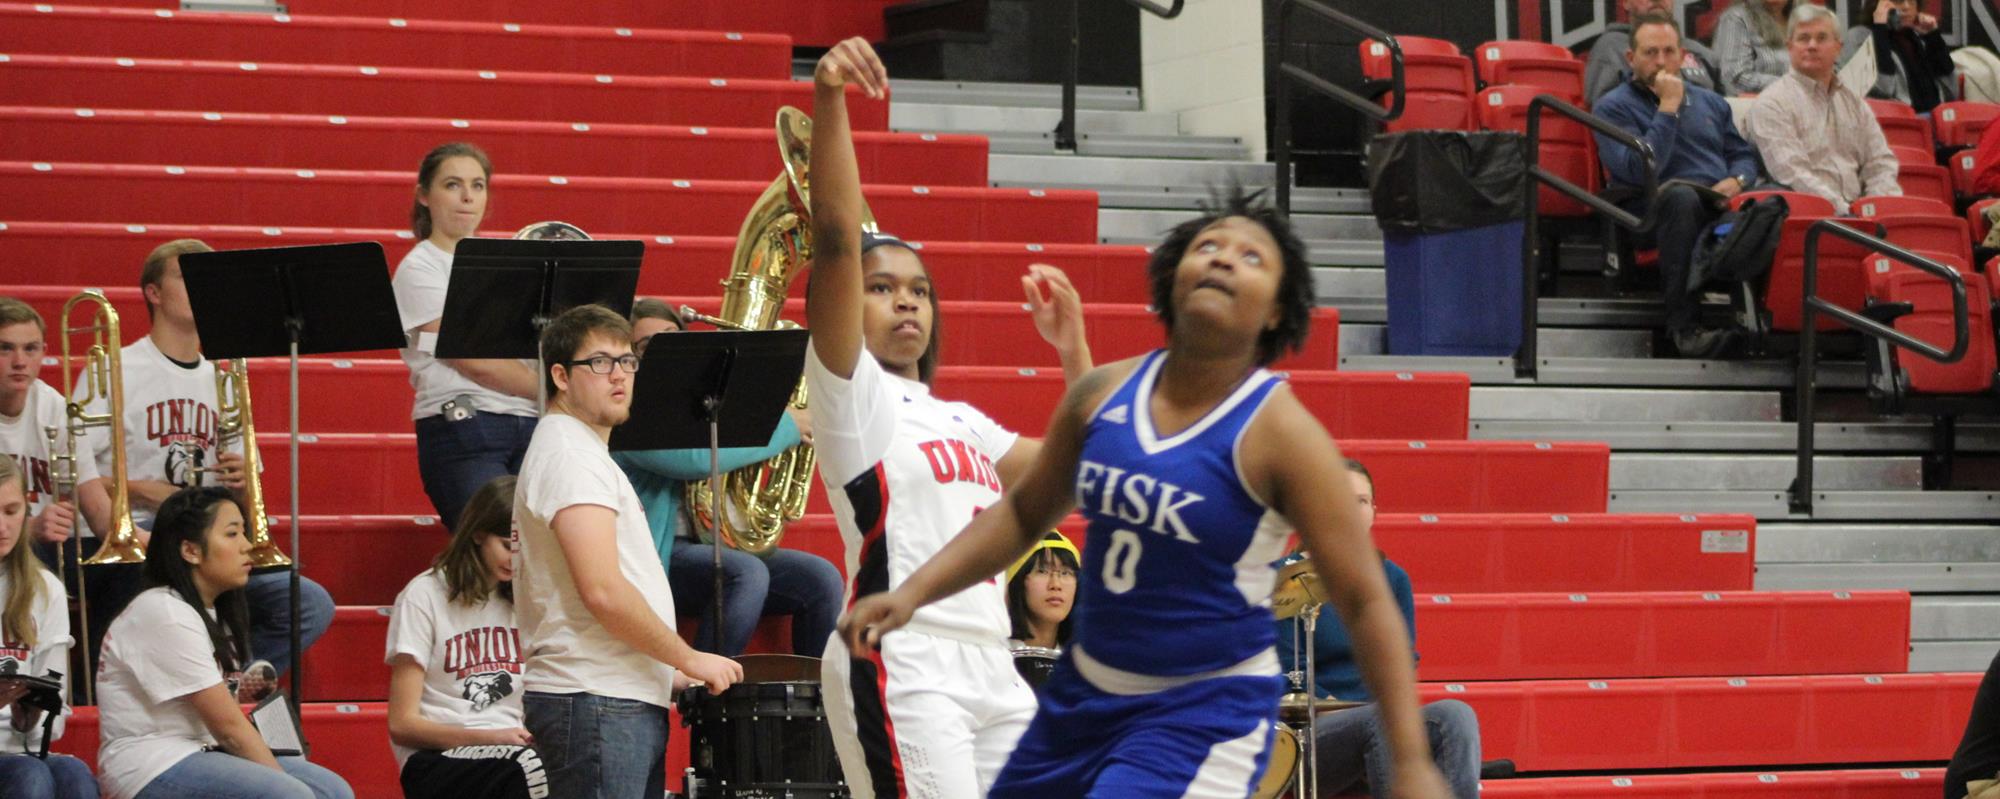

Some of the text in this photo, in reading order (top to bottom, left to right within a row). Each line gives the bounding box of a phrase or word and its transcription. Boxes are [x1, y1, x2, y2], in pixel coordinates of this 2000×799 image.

[918, 438, 1001, 493] UNIO
[1076, 460, 1205, 544] FISK
[1102, 529, 1143, 594] 0
[516, 748, 549, 799] BAND
